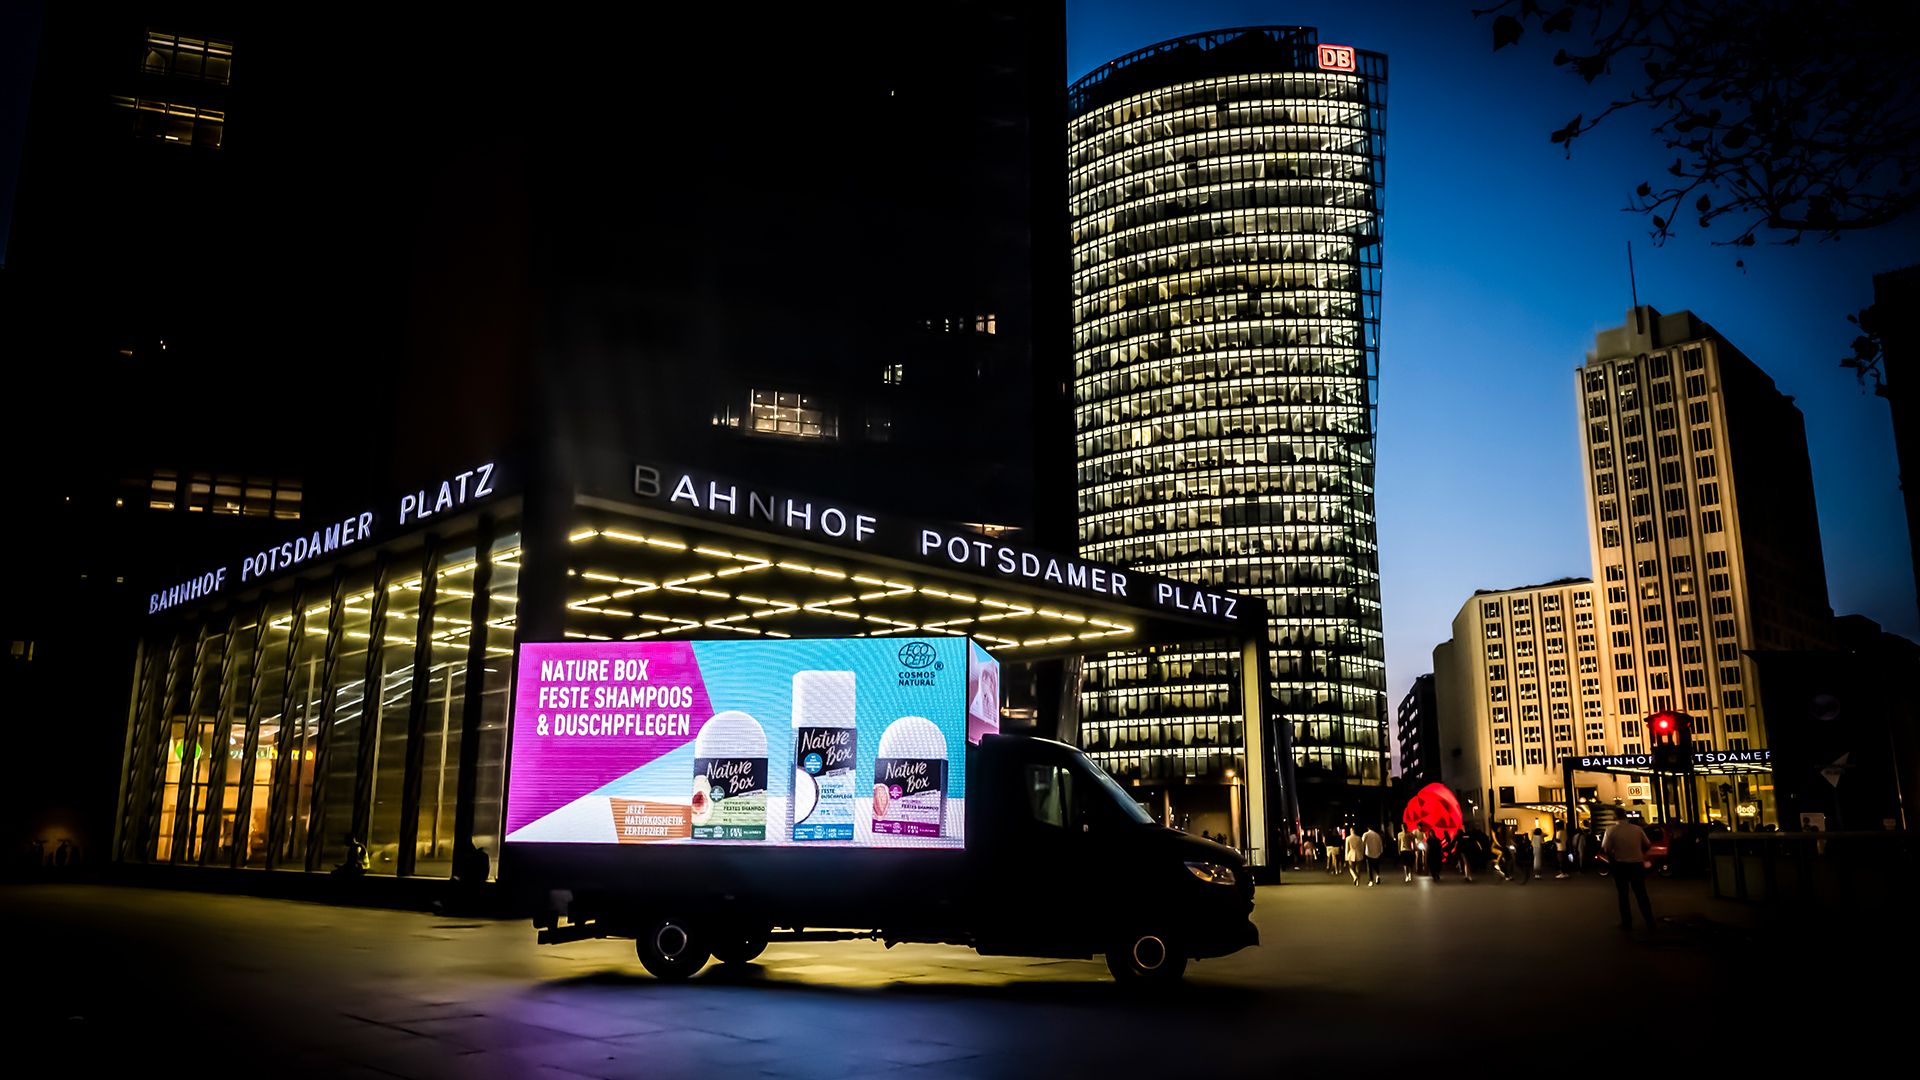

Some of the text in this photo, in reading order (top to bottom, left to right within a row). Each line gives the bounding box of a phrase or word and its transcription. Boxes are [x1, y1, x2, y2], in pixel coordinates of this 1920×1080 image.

[1322, 48, 1351, 67] DB
[149, 463, 494, 614] BAHNHOF POTSDAMER PLATZ
[633, 464, 1238, 619] BAHNHOF POTSDAMER PLATZ
[906, 644, 929, 655] ECO
[905, 654, 931, 666] CERT
[541, 659, 650, 682] NATURE BOX
[898, 671, 936, 679] COSMOS
[898, 679, 936, 687] NATURAL
[539, 686, 693, 709] FESTE SHAMPOOS
[536, 713, 690, 736] & DUSCHPFLEGEN
[801, 728, 850, 753] Nature
[826, 745, 854, 767] Box
[1694, 751, 1771, 763] TSDAMER
[706, 759, 753, 780] Nature
[885, 760, 928, 781] Nature
[729, 775, 756, 794] Box
[906, 775, 930, 794] Box
[626, 805, 645, 814] JETZT
[624, 816, 686, 826] NATURKOSMETIK-
[624, 826, 669, 836] ZERTIFIZIERT
